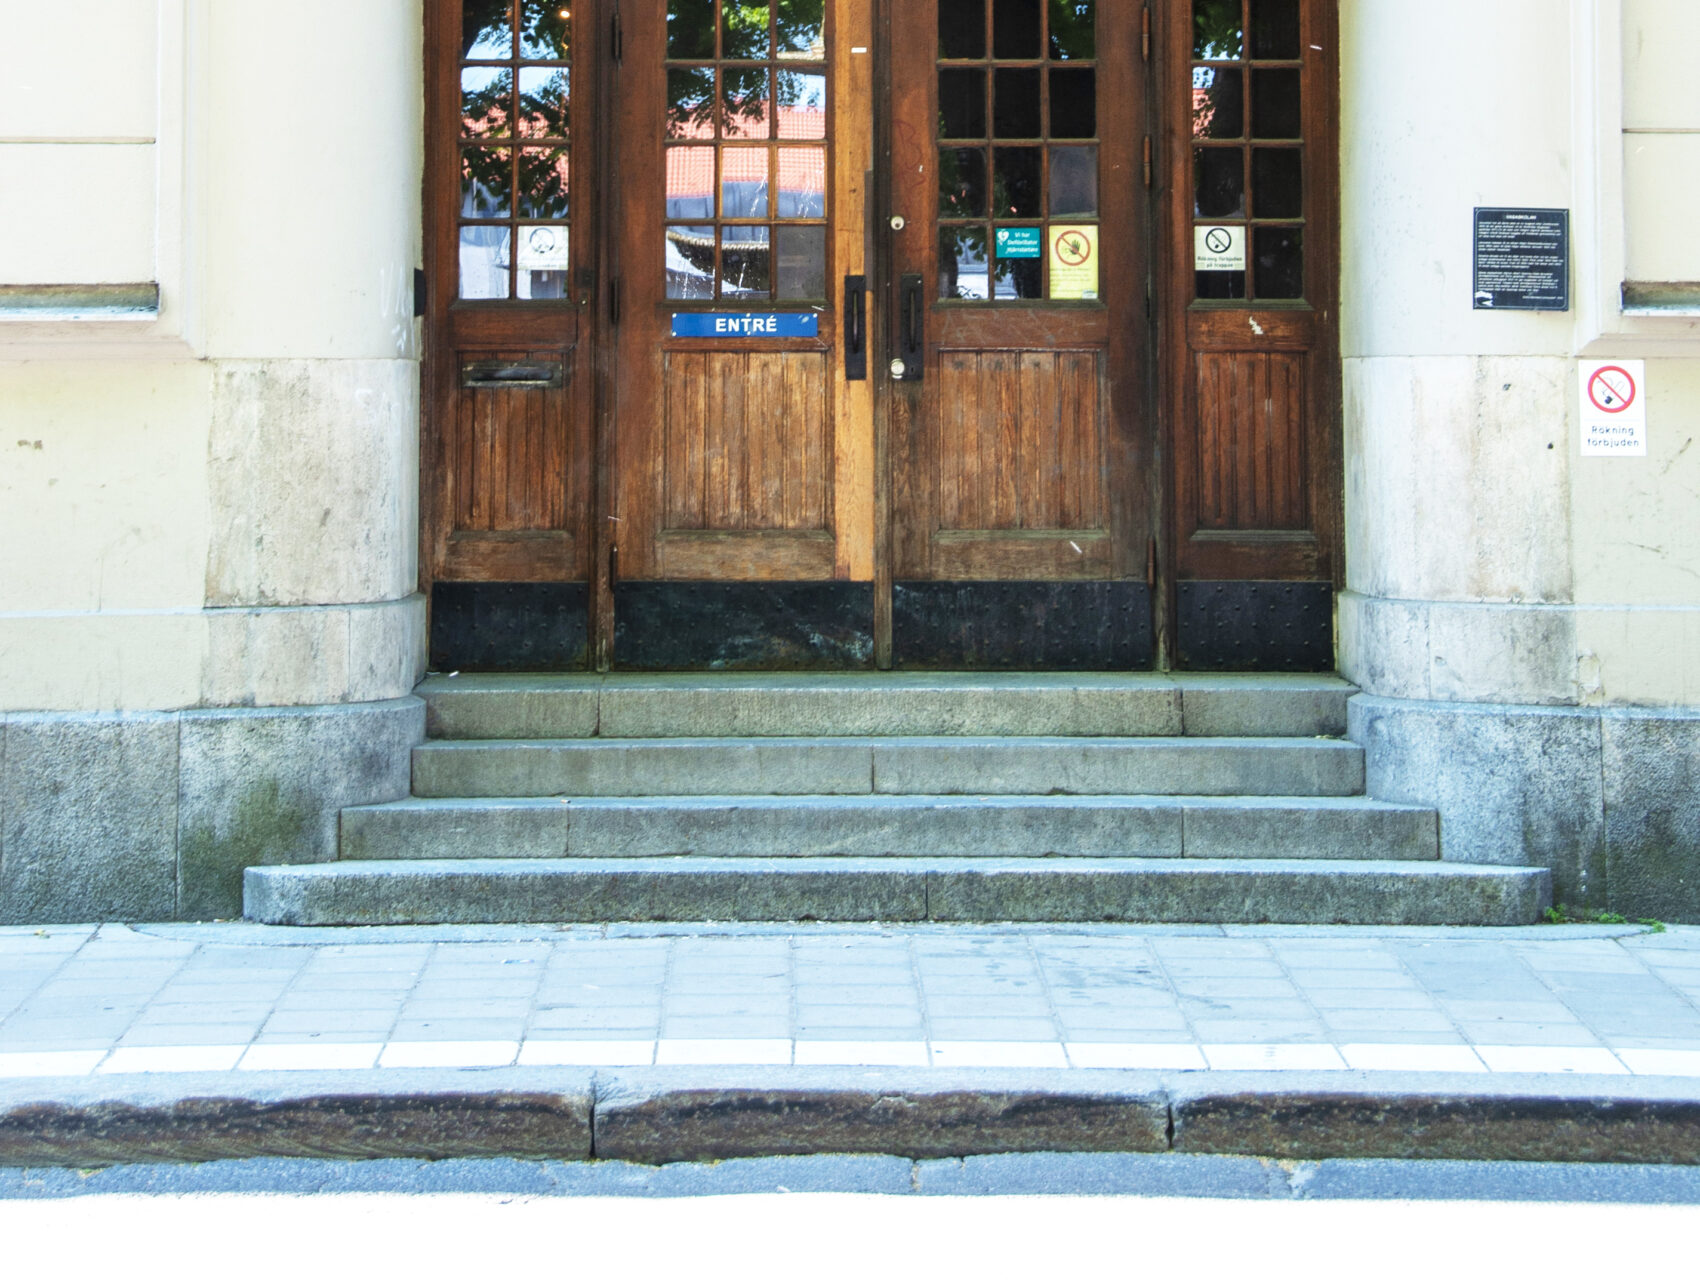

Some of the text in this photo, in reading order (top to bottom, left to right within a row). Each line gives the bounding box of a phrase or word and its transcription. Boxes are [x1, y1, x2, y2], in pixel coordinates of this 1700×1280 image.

[715, 314, 778, 332] ENTRÉ
[1591, 424, 1634, 436] Rökning
[1587, 437, 1640, 448] förbjuden
